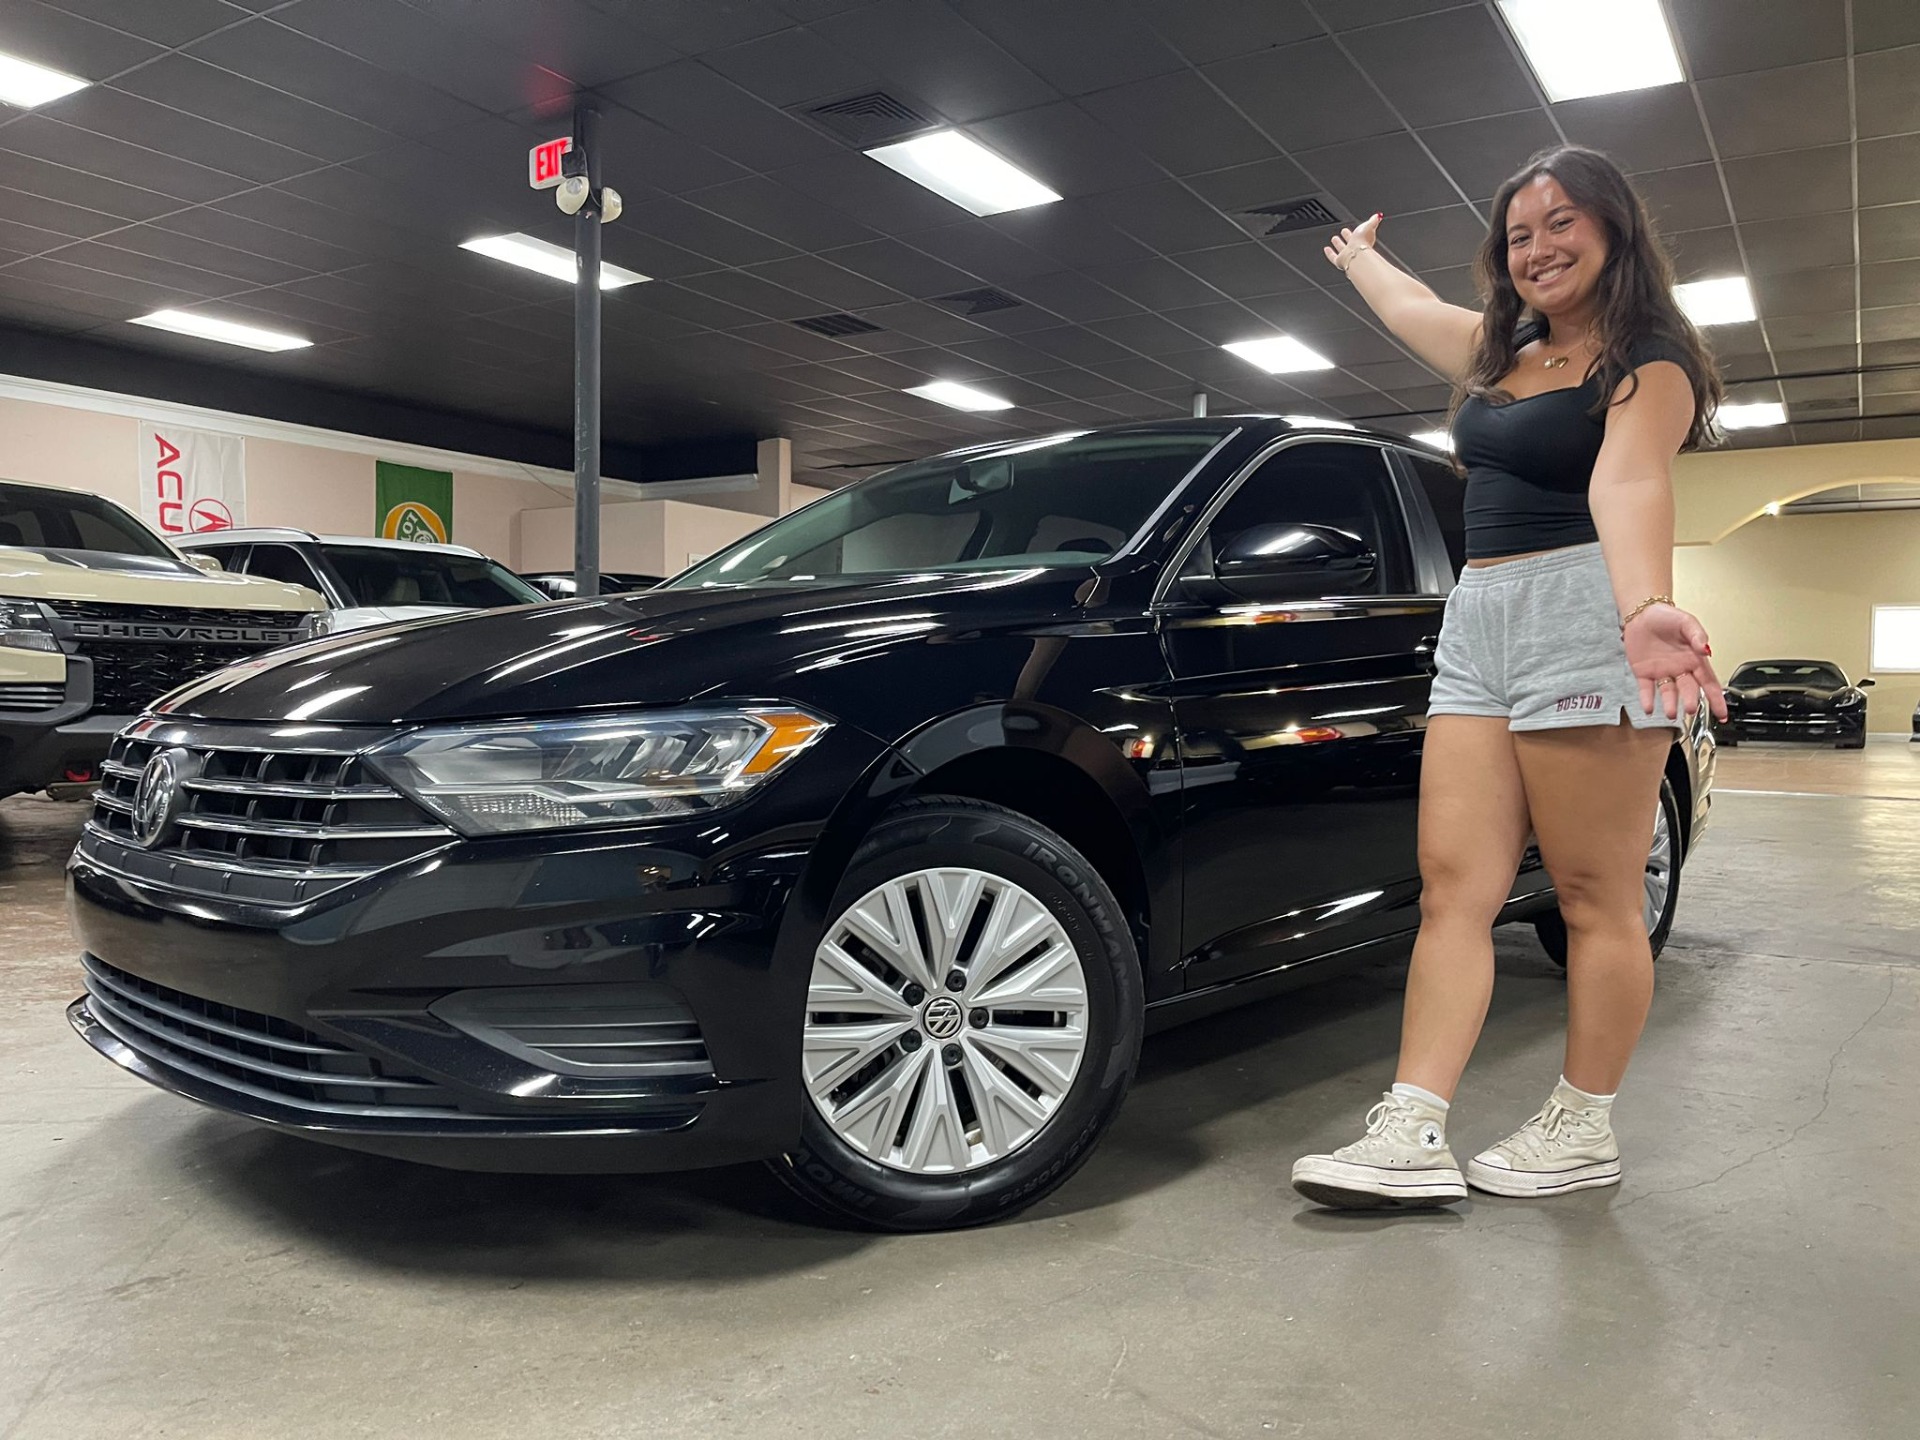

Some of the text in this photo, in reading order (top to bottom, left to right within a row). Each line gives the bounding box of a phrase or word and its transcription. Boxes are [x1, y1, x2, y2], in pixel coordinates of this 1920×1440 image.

[154, 433, 184, 532] ACU
[73, 622, 299, 642] CHEVROLET
[1556, 695, 1602, 712] BOSTON
[1022, 842, 1129, 982] IRONMAN
